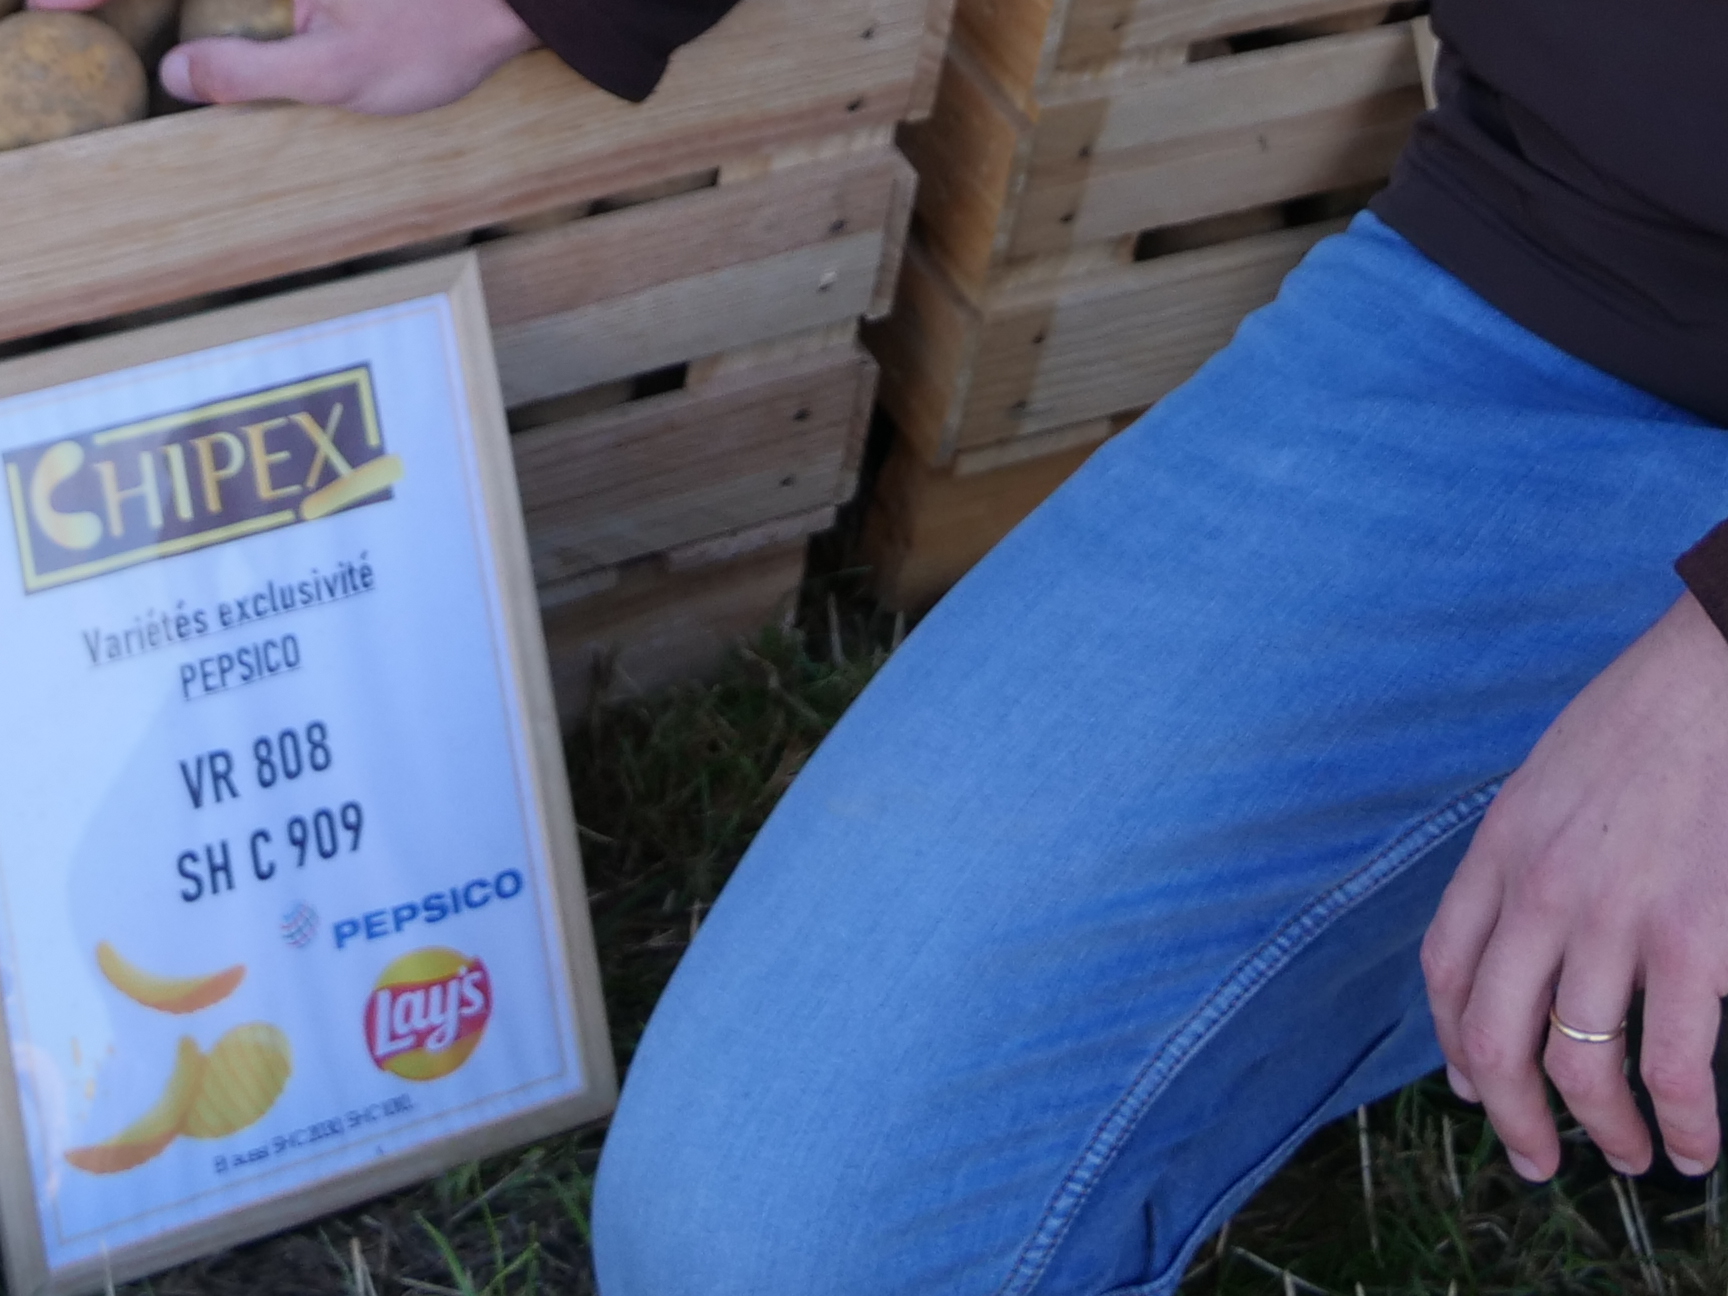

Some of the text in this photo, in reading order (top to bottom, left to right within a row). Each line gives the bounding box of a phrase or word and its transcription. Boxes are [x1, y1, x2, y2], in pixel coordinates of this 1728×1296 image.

[29, 402, 358, 551] CHIPEX
[82, 549, 375, 665] Variétés exclusivité
[179, 633, 302, 699] PEPSICO
[178, 719, 333, 810] VR 808
[176, 800, 365, 903] SH C 909
[331, 867, 525, 950] PEPSICO
[373, 963, 487, 1058] Lay's
